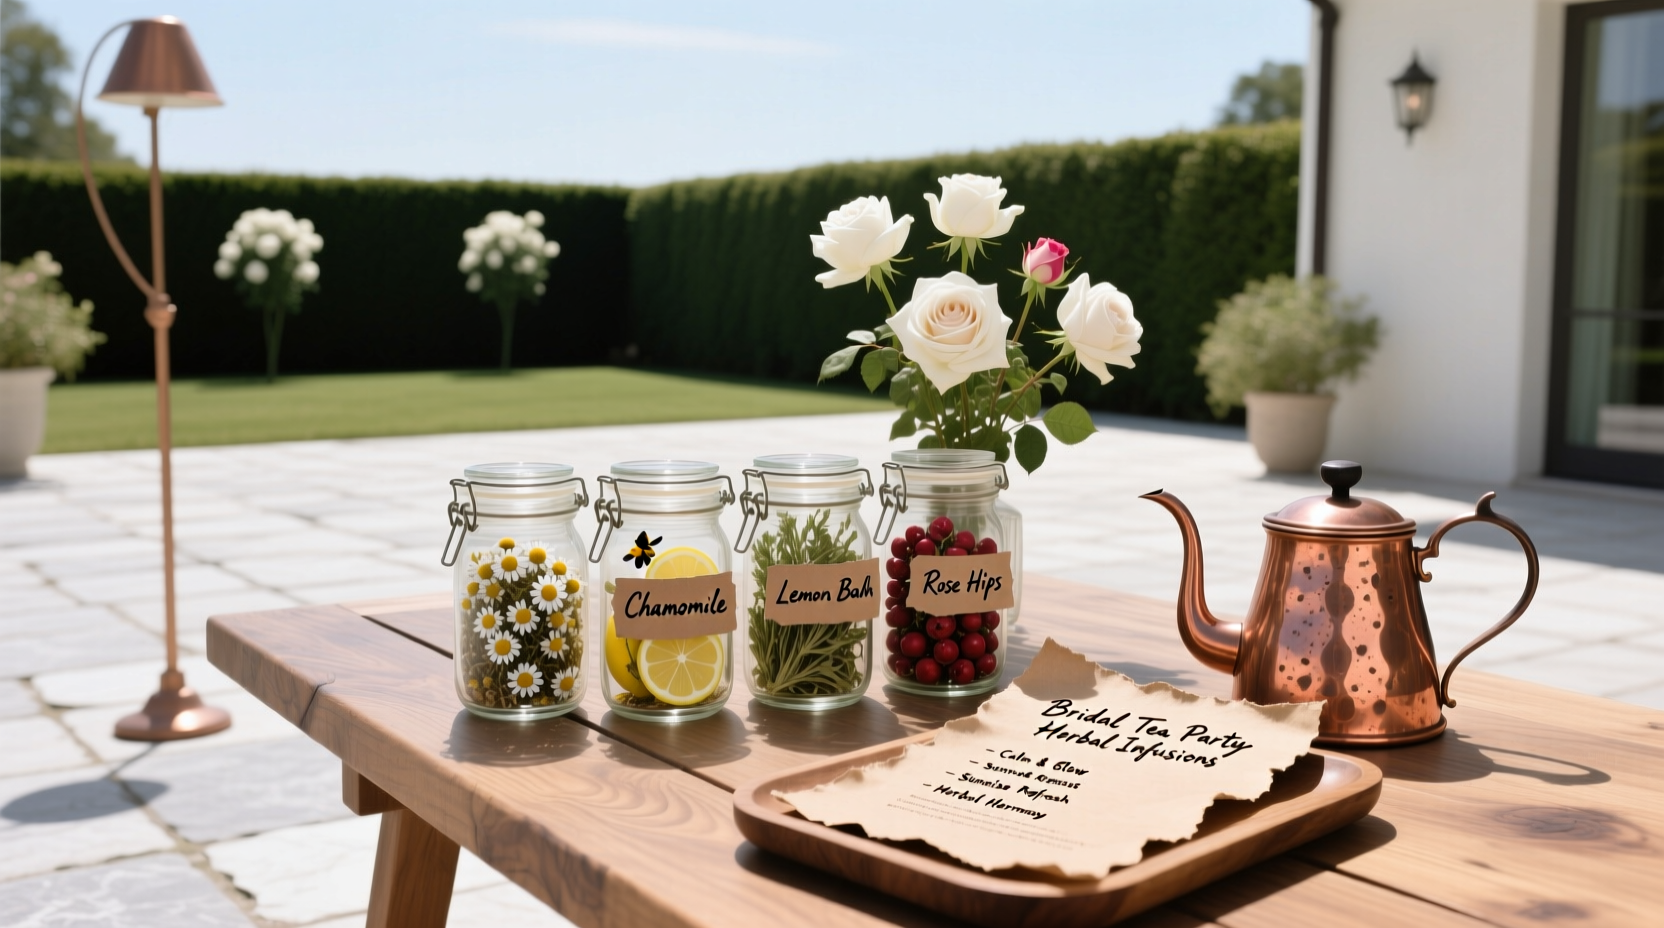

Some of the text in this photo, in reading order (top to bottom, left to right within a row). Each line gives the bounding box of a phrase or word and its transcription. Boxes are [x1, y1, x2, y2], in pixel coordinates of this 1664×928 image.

[775, 579, 832, 605] Lemon
[922, 568, 1003, 601] Rose Hips
[624, 587, 728, 619] Chamomile
[1033, 720, 1219, 768] Herbal Infusions
[1040, 699, 1254, 758] Bridal Tea Party
